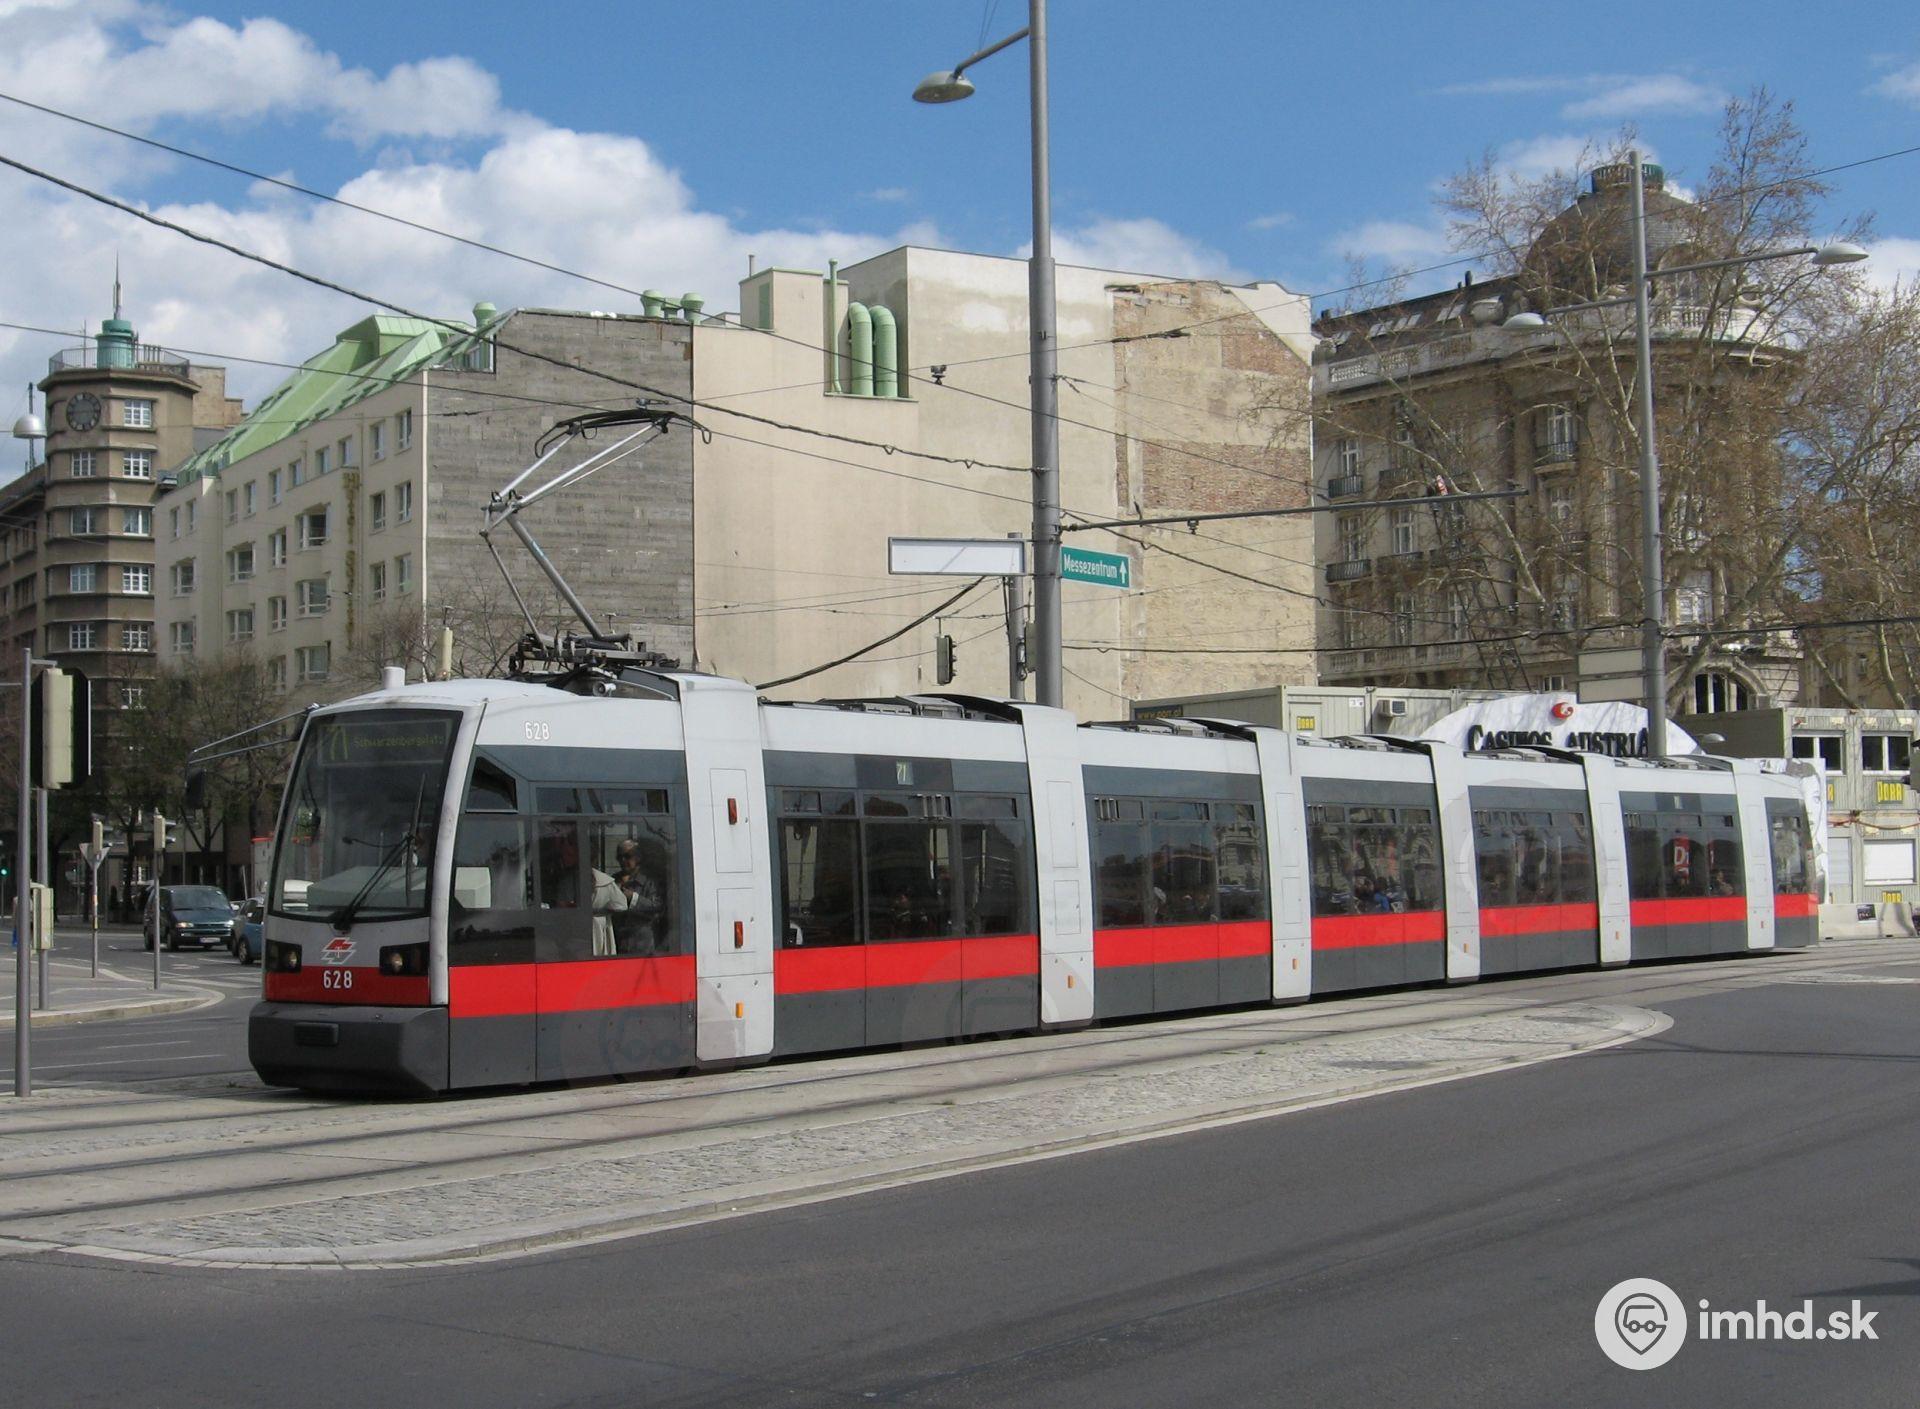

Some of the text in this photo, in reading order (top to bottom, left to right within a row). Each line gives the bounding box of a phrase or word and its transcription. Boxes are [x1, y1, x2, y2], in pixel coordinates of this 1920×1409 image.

[1063, 554, 1117, 578] Messezentrum
[525, 721, 550, 740] 628
[323, 970, 352, 989] 628
